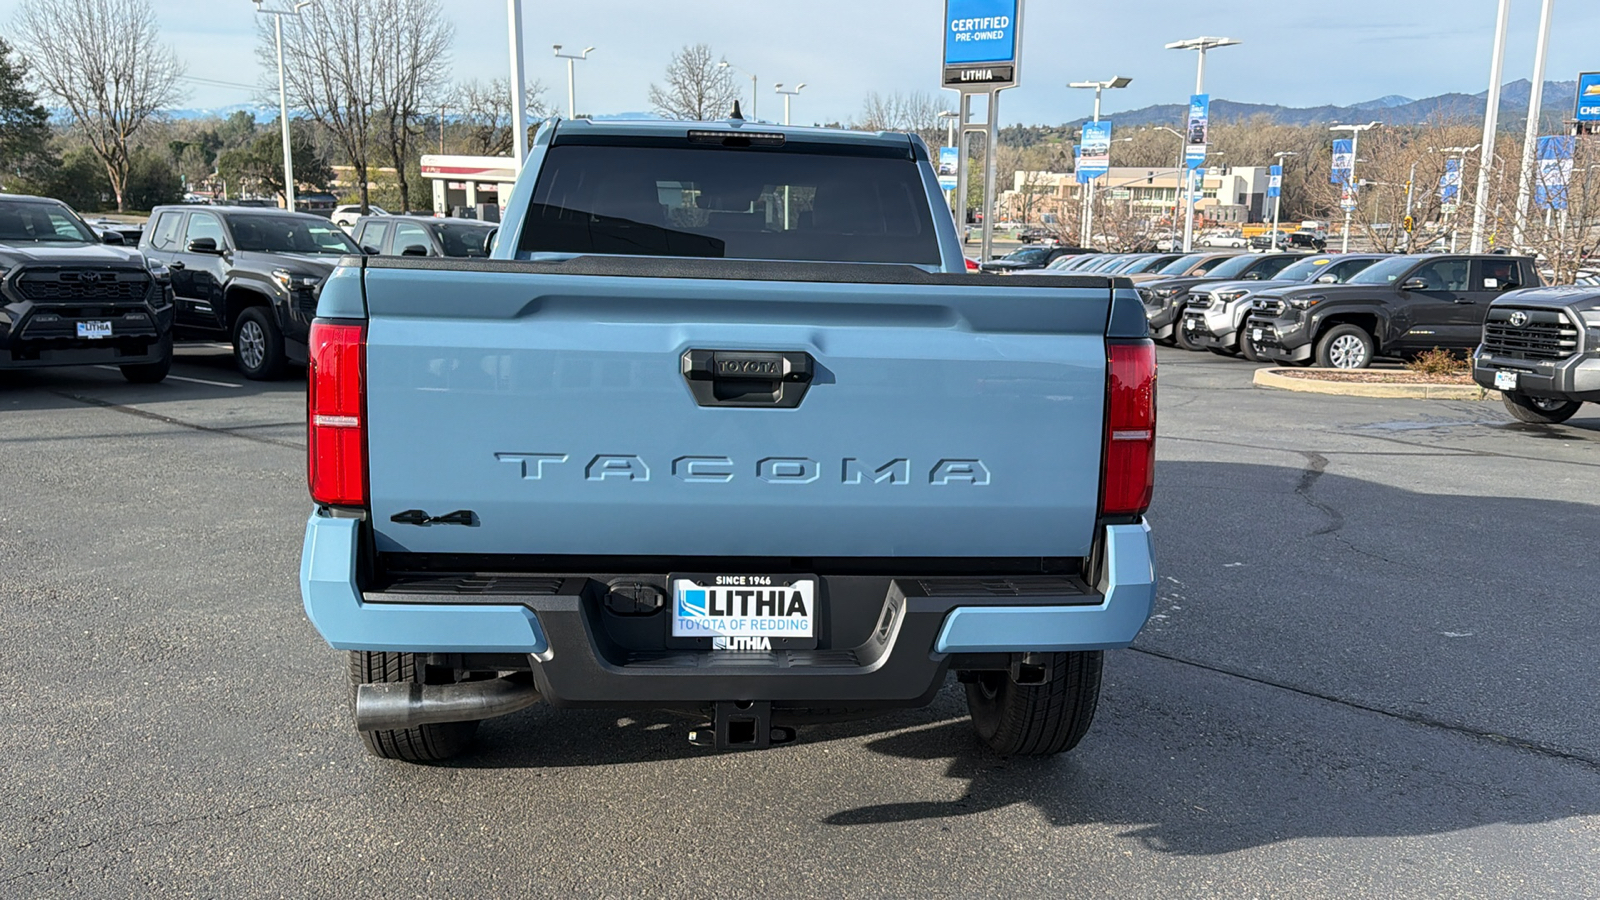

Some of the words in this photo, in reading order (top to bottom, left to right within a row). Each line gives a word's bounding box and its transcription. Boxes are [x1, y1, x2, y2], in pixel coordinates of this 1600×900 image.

[951, 16, 1009, 31] CERTIFIED
[955, 30, 1004, 42] PRE-OWNED
[961, 69, 993, 80] LITHIA
[718, 361, 780, 373] TOYOTA
[494, 452, 990, 485] TACOMA
[716, 575, 746, 585] SINCE
[749, 576, 771, 585] 1946
[709, 590, 807, 616] LITHIA
[678, 619, 727, 631] TOYOTA
[730, 619, 747, 631] OF
[750, 619, 808, 631] REDDING
[726, 636, 772, 650] LITHIA
